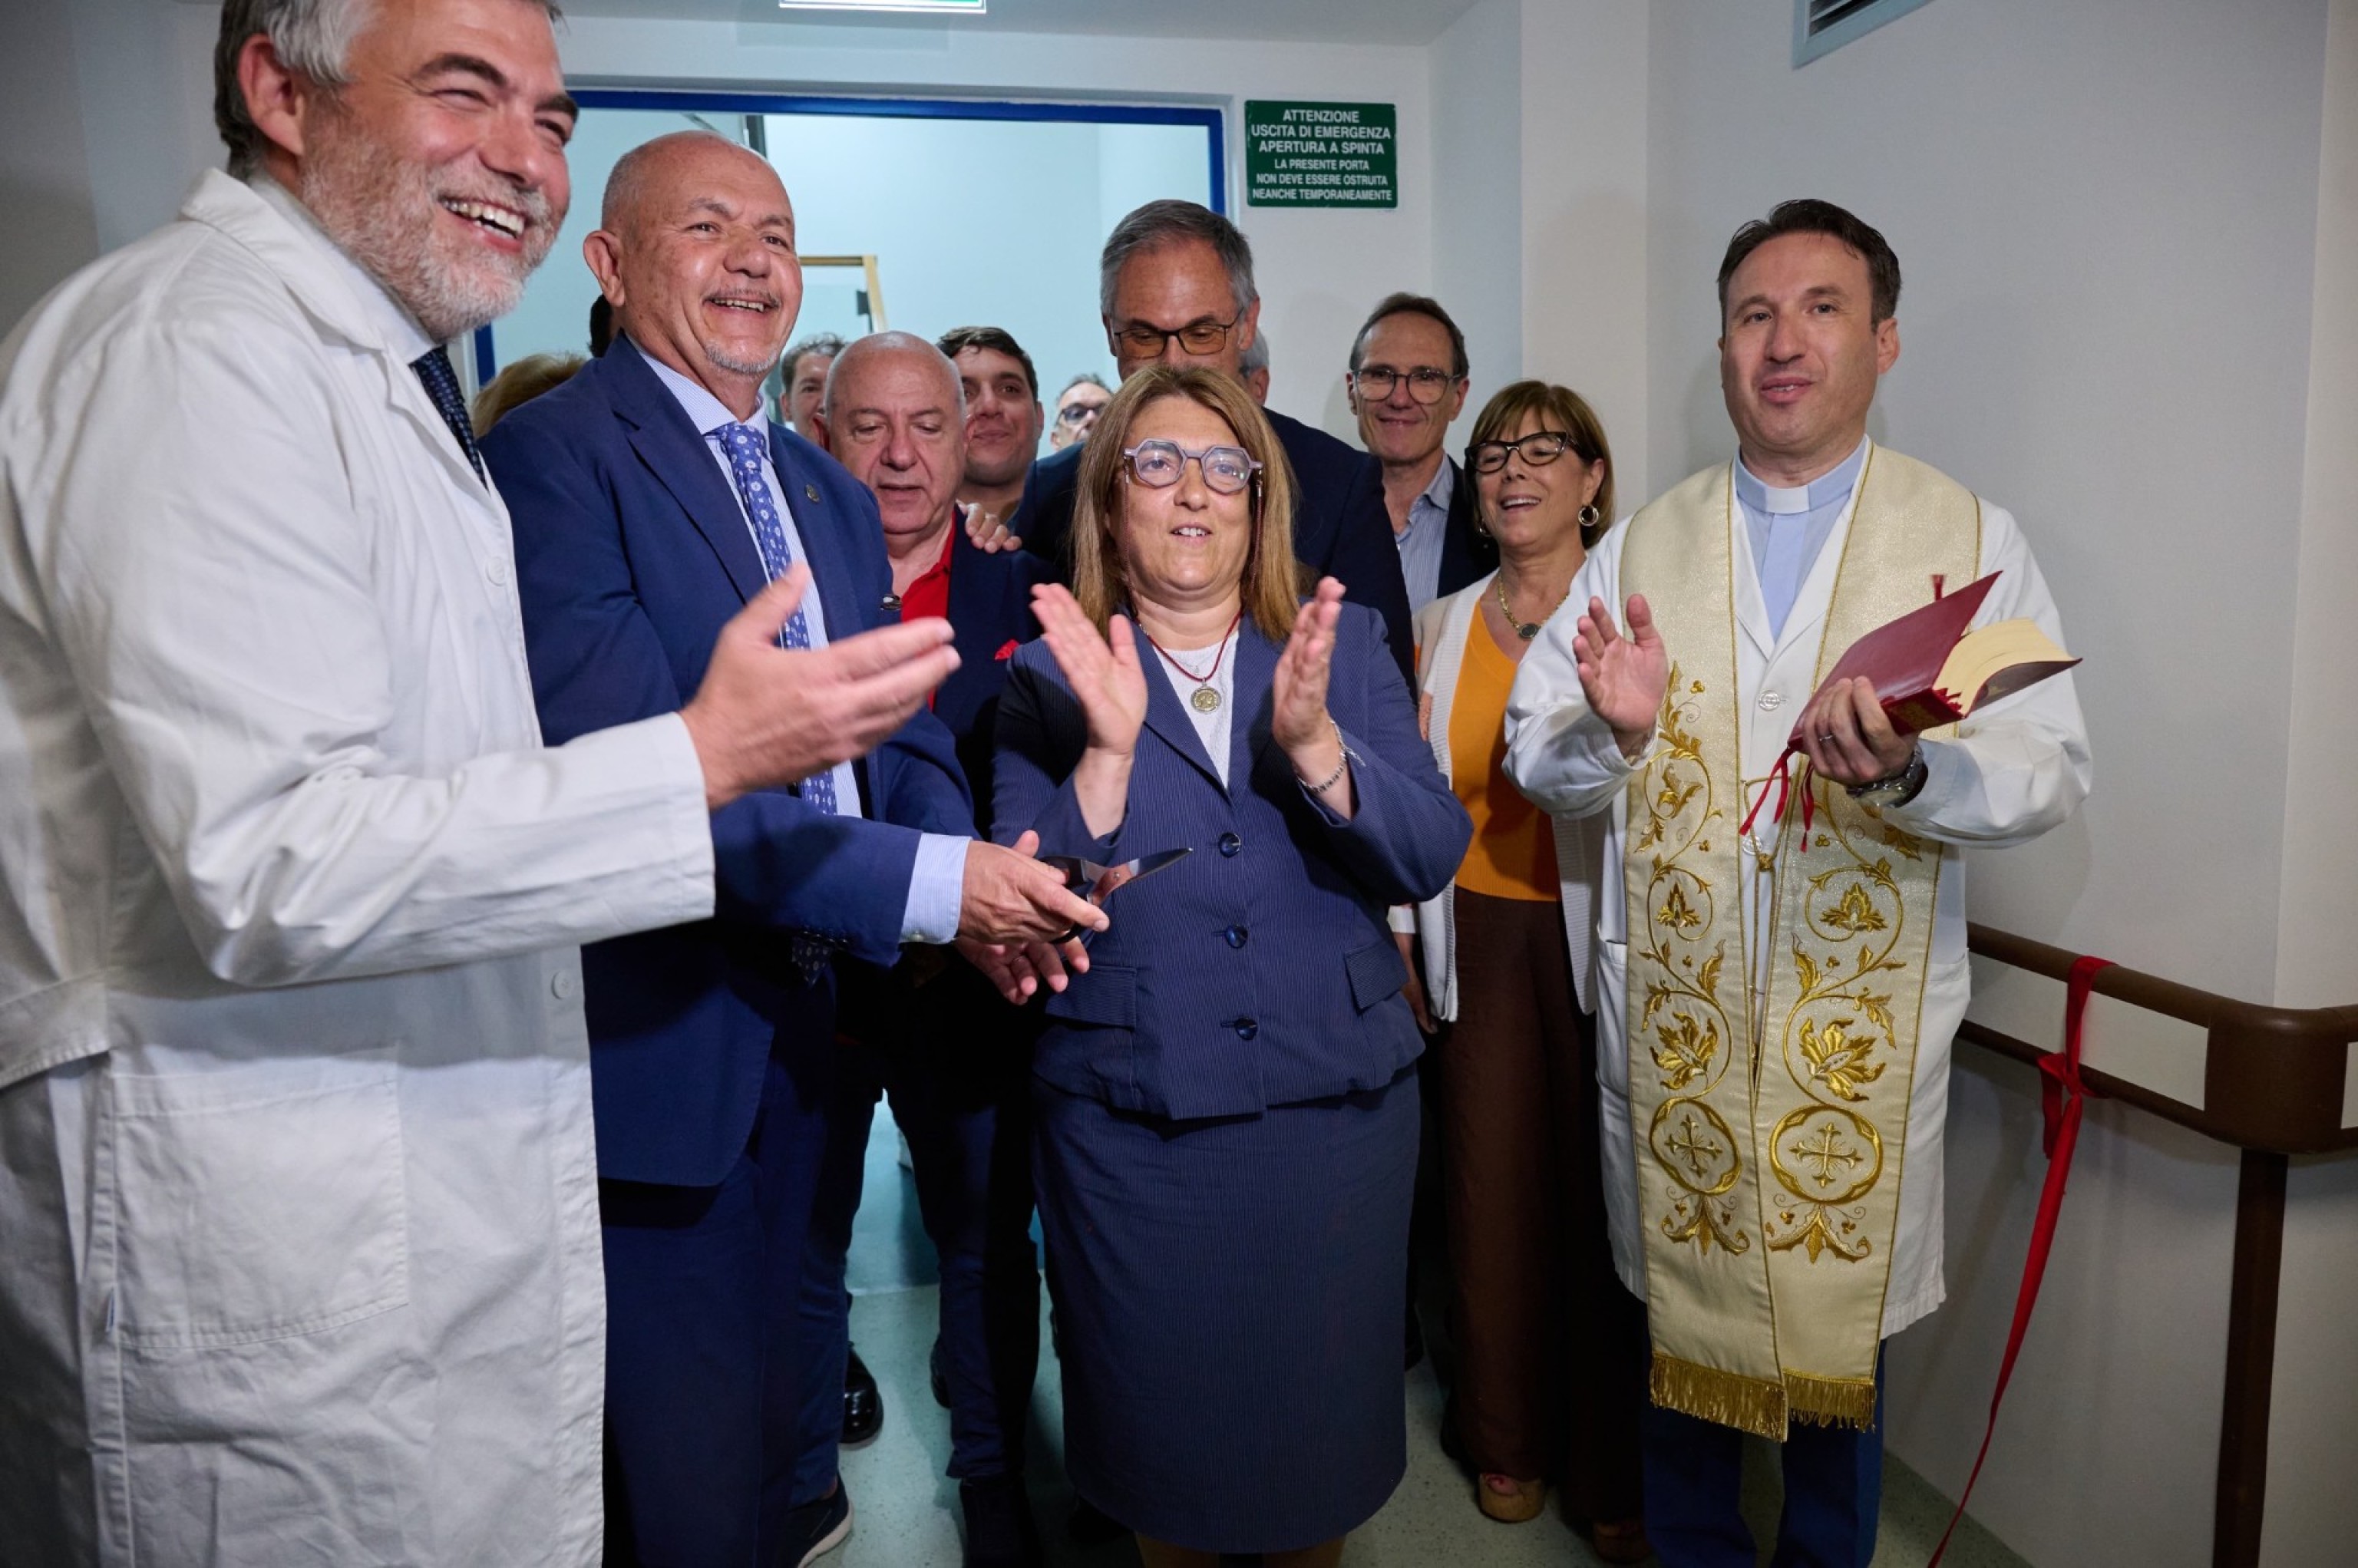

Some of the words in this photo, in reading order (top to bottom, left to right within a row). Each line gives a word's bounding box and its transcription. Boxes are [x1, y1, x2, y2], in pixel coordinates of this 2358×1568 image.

[1283, 110, 1359, 123] ATTENZIONE
[1251, 124, 1296, 137] USCITA
[1300, 126, 1311, 137] DI
[1315, 126, 1391, 139] EMERGENZA
[1259, 141, 1326, 153] APERTURA
[1329, 142, 1338, 153] A
[1342, 142, 1384, 154] SPINTA
[1275, 160, 1287, 169] LA
[1290, 160, 1336, 170] PRESENTE
[1339, 160, 1369, 170] PORTA
[1257, 173, 1276, 183] NON
[1280, 174, 1303, 184] DEVE
[1306, 174, 1341, 185] ESSERE
[1343, 175, 1388, 186] OSTRUITA
[1253, 188, 1296, 199] NEANCHE
[1300, 190, 1392, 200] TEMPORANEAMENTE
